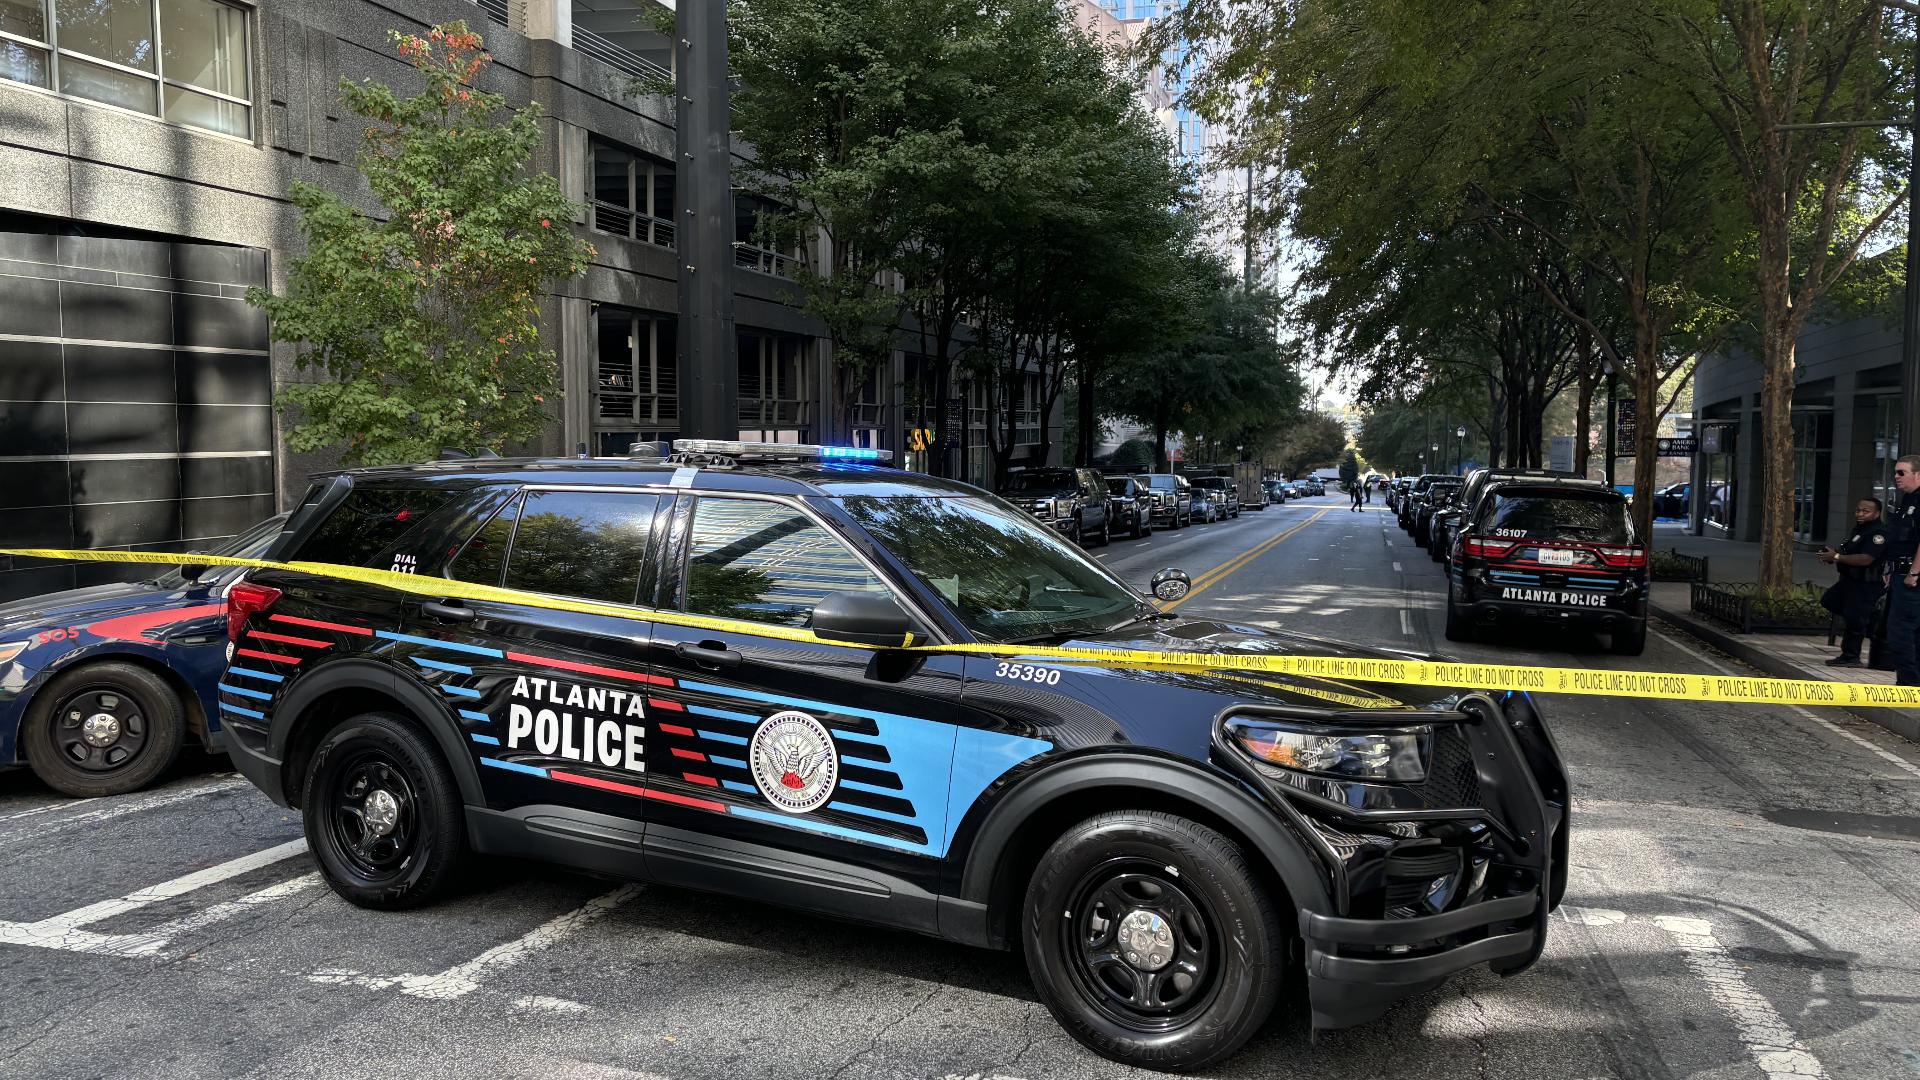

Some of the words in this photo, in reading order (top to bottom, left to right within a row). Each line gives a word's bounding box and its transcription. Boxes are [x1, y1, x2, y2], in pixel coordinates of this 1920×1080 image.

[1496, 528, 1527, 538] 36107
[394, 554, 417, 564] DIAL
[1502, 587, 1557, 603] ATLANTA
[1561, 592, 1607, 606] POLICE
[1161, 651, 1188, 664] POLICE
[1190, 652, 1208, 665] LINE
[1210, 653, 1221, 667] DO
[1223, 654, 1239, 668] NOT
[1241, 655, 1268, 670] CROSS
[1297, 658, 1325, 674] POLICE
[1327, 661, 1345, 676] LINE
[1347, 661, 1358, 677] DO
[1360, 662, 1377, 678] NOT
[1378, 663, 1405, 680] CROSS
[996, 662, 1061, 686] 35390
[1435, 665, 1463, 682] POLICE
[1466, 667, 1484, 684] LINE
[1486, 668, 1497, 685] DO
[1499, 669, 1515, 686] NOT
[1517, 670, 1544, 687] CROSS
[1574, 672, 1603, 689] POLICE
[1605, 674, 1624, 690] LINE
[1625, 675, 1637, 691] DO
[1639, 675, 1655, 692] NOT
[1658, 677, 1687, 694] CROSS
[511, 675, 645, 719] ATLANTA
[1718, 679, 1747, 697] POLICE
[1749, 681, 1768, 698] LINE
[1771, 682, 1782, 699] DO
[1785, 683, 1801, 700] NOT
[1804, 684, 1834, 702] CROSS
[1864, 686, 1897, 702] POLICE
[1895, 688, 1918, 703] LINE
[508, 703, 646, 773] POLICE
